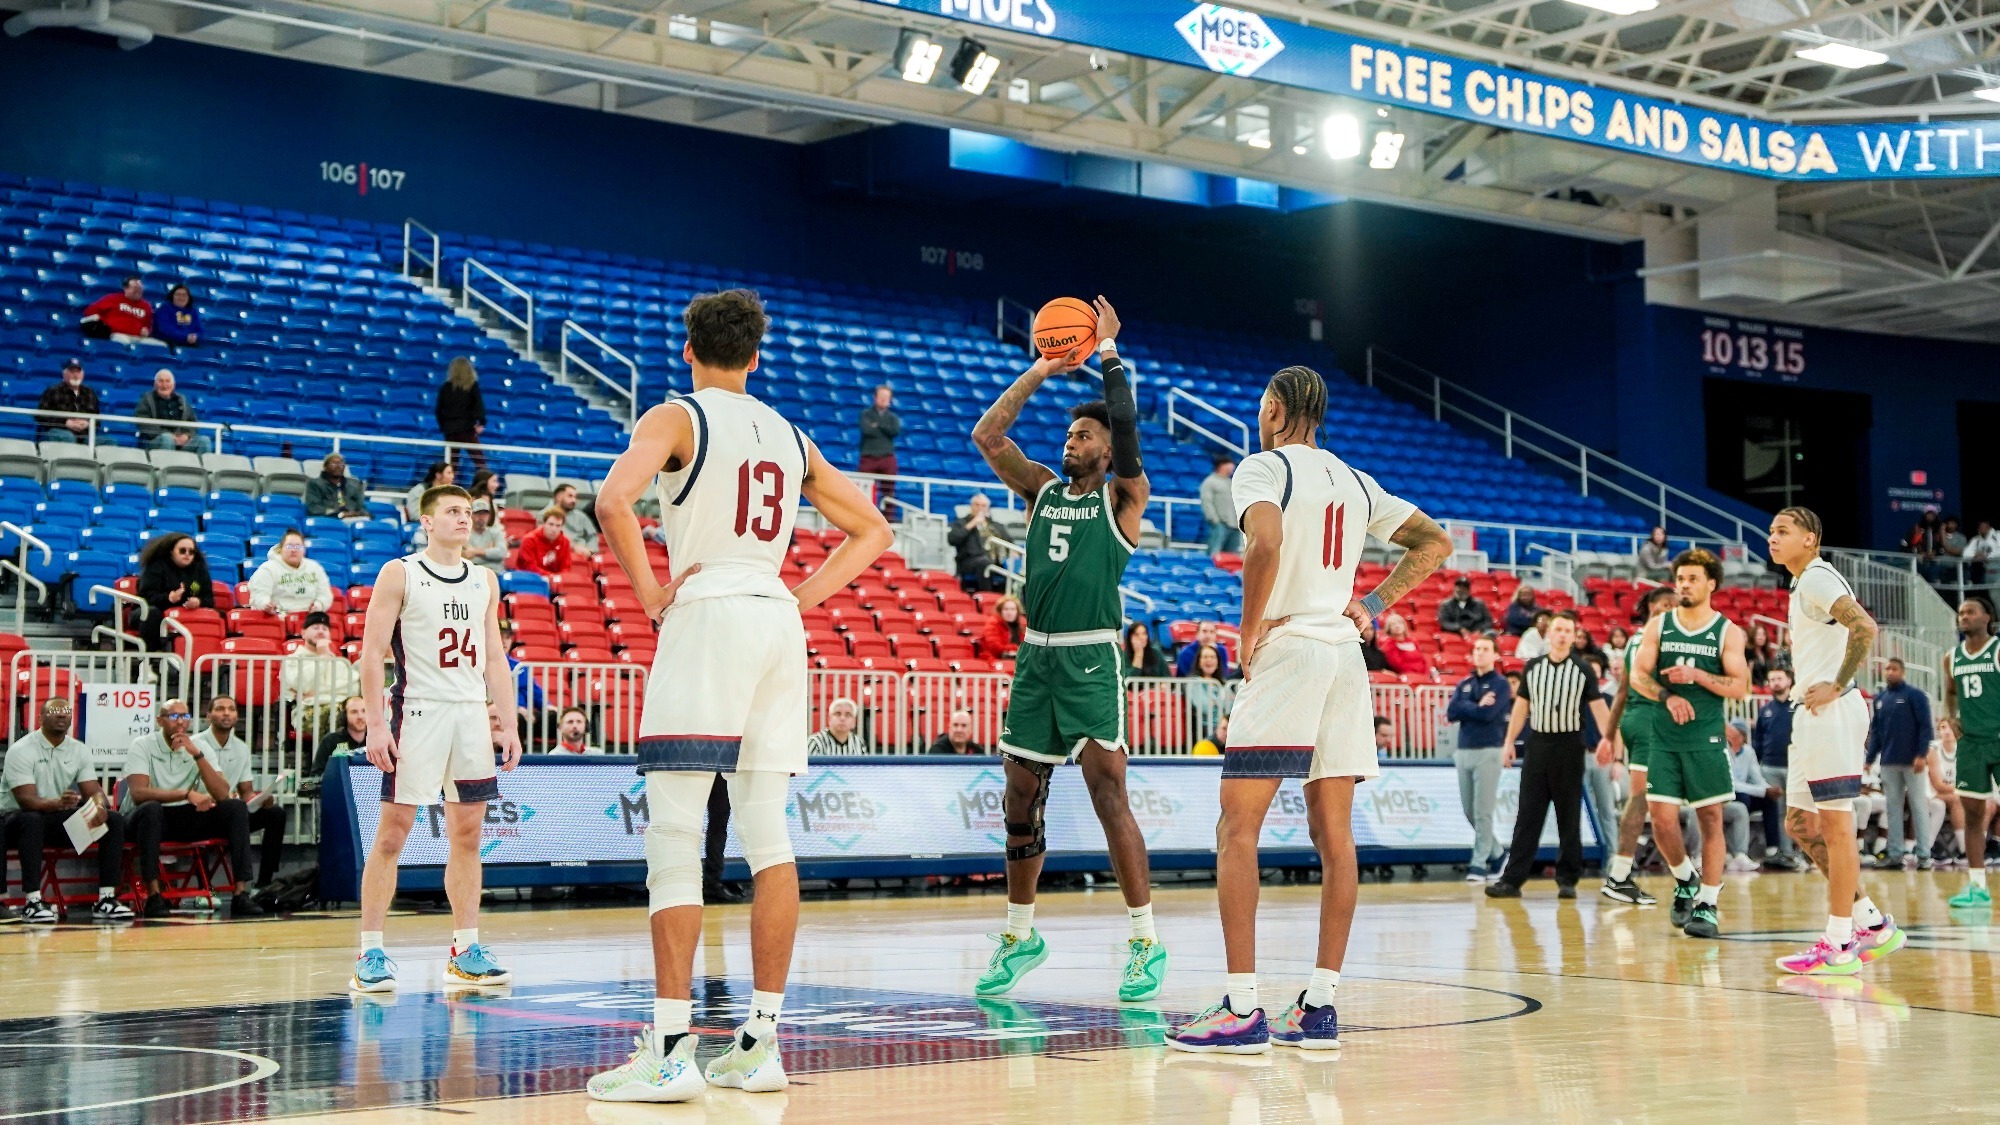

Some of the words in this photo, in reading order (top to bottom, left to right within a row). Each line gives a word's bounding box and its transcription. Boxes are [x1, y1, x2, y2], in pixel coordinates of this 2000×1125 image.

[1350, 44, 1453, 109] FREE
[1464, 70, 1595, 136] CHIPS
[1606, 98, 1689, 153] AND
[1700, 117, 1838, 175] SALSA
[320, 161, 358, 185] 106
[369, 168, 406, 191] 107
[921, 246, 947, 265] 107
[1037, 335, 1078, 349] Wilson
[1701, 329, 1733, 366] 10
[1737, 335, 1770, 371] 13
[1774, 340, 1806, 375] 15
[734, 458, 785, 542] 13
[1048, 523, 1073, 562] 5
[1322, 500, 1345, 571] 11
[443, 603, 469, 621] FDU
[438, 627, 477, 668] 24
[1661, 641, 1718, 658] JACKSONVILLE
[112, 691, 151, 709] 105
[1962, 674, 1983, 699] 13
[91, 748, 115, 756] UPMC
